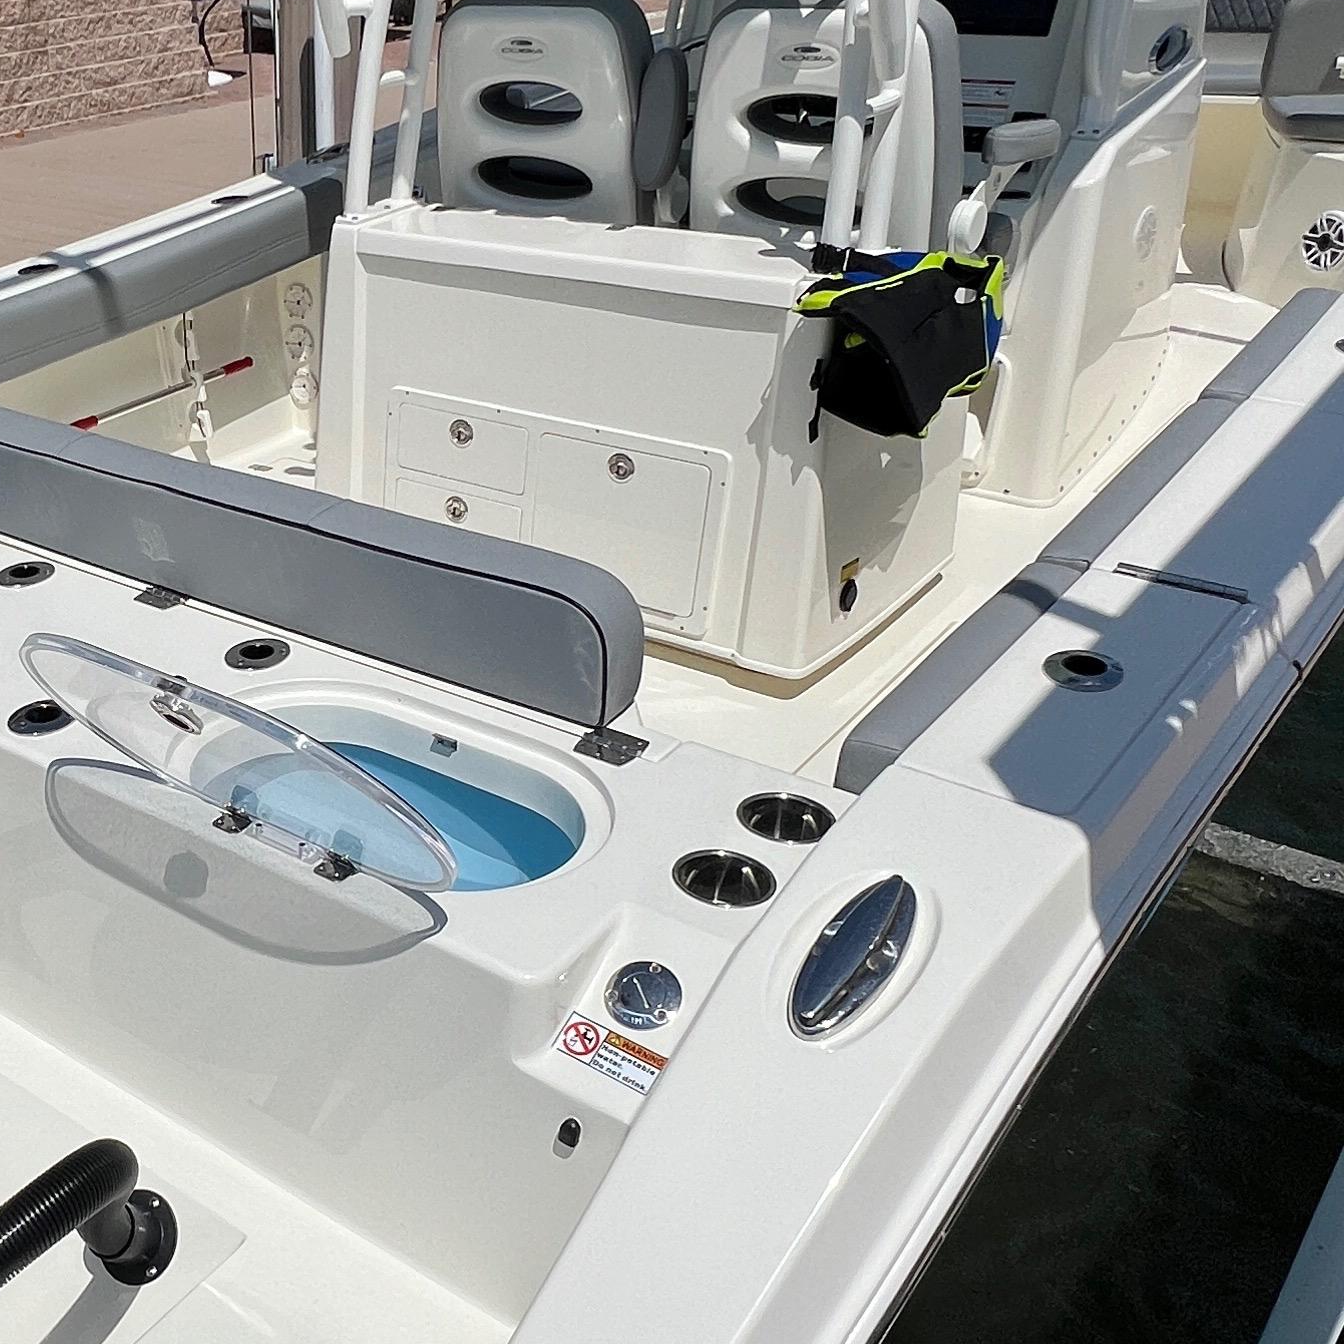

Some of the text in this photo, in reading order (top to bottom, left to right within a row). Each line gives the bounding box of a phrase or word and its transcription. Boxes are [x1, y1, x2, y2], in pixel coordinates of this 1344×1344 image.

[601, 1045, 656, 1076] Non-potable
[621, 1040, 665, 1067] WARNING
[592, 1059, 604, 1069] Do
[606, 1066, 621, 1078] not
